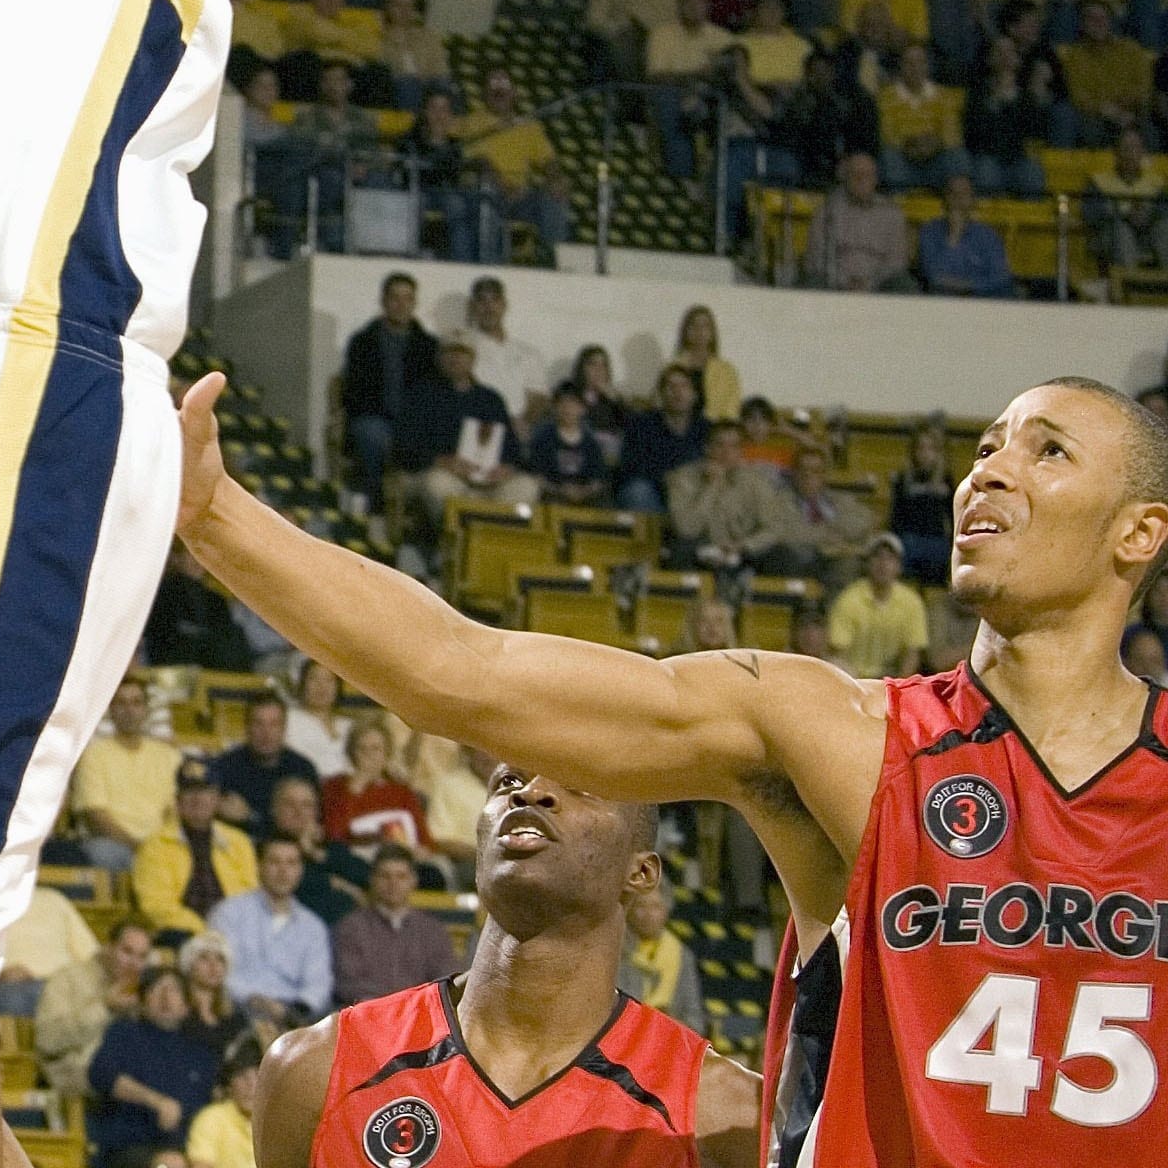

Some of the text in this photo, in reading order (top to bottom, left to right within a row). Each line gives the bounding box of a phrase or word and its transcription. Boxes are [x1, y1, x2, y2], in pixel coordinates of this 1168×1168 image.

[931, 782, 1002, 819] DO IT FOR BROPH
[952, 798, 977, 834] 3
[925, 972, 1159, 1127] 45
[372, 1120, 384, 1133] DO
[392, 1104, 412, 1115] FOR
[391, 1118, 415, 1153] 3
